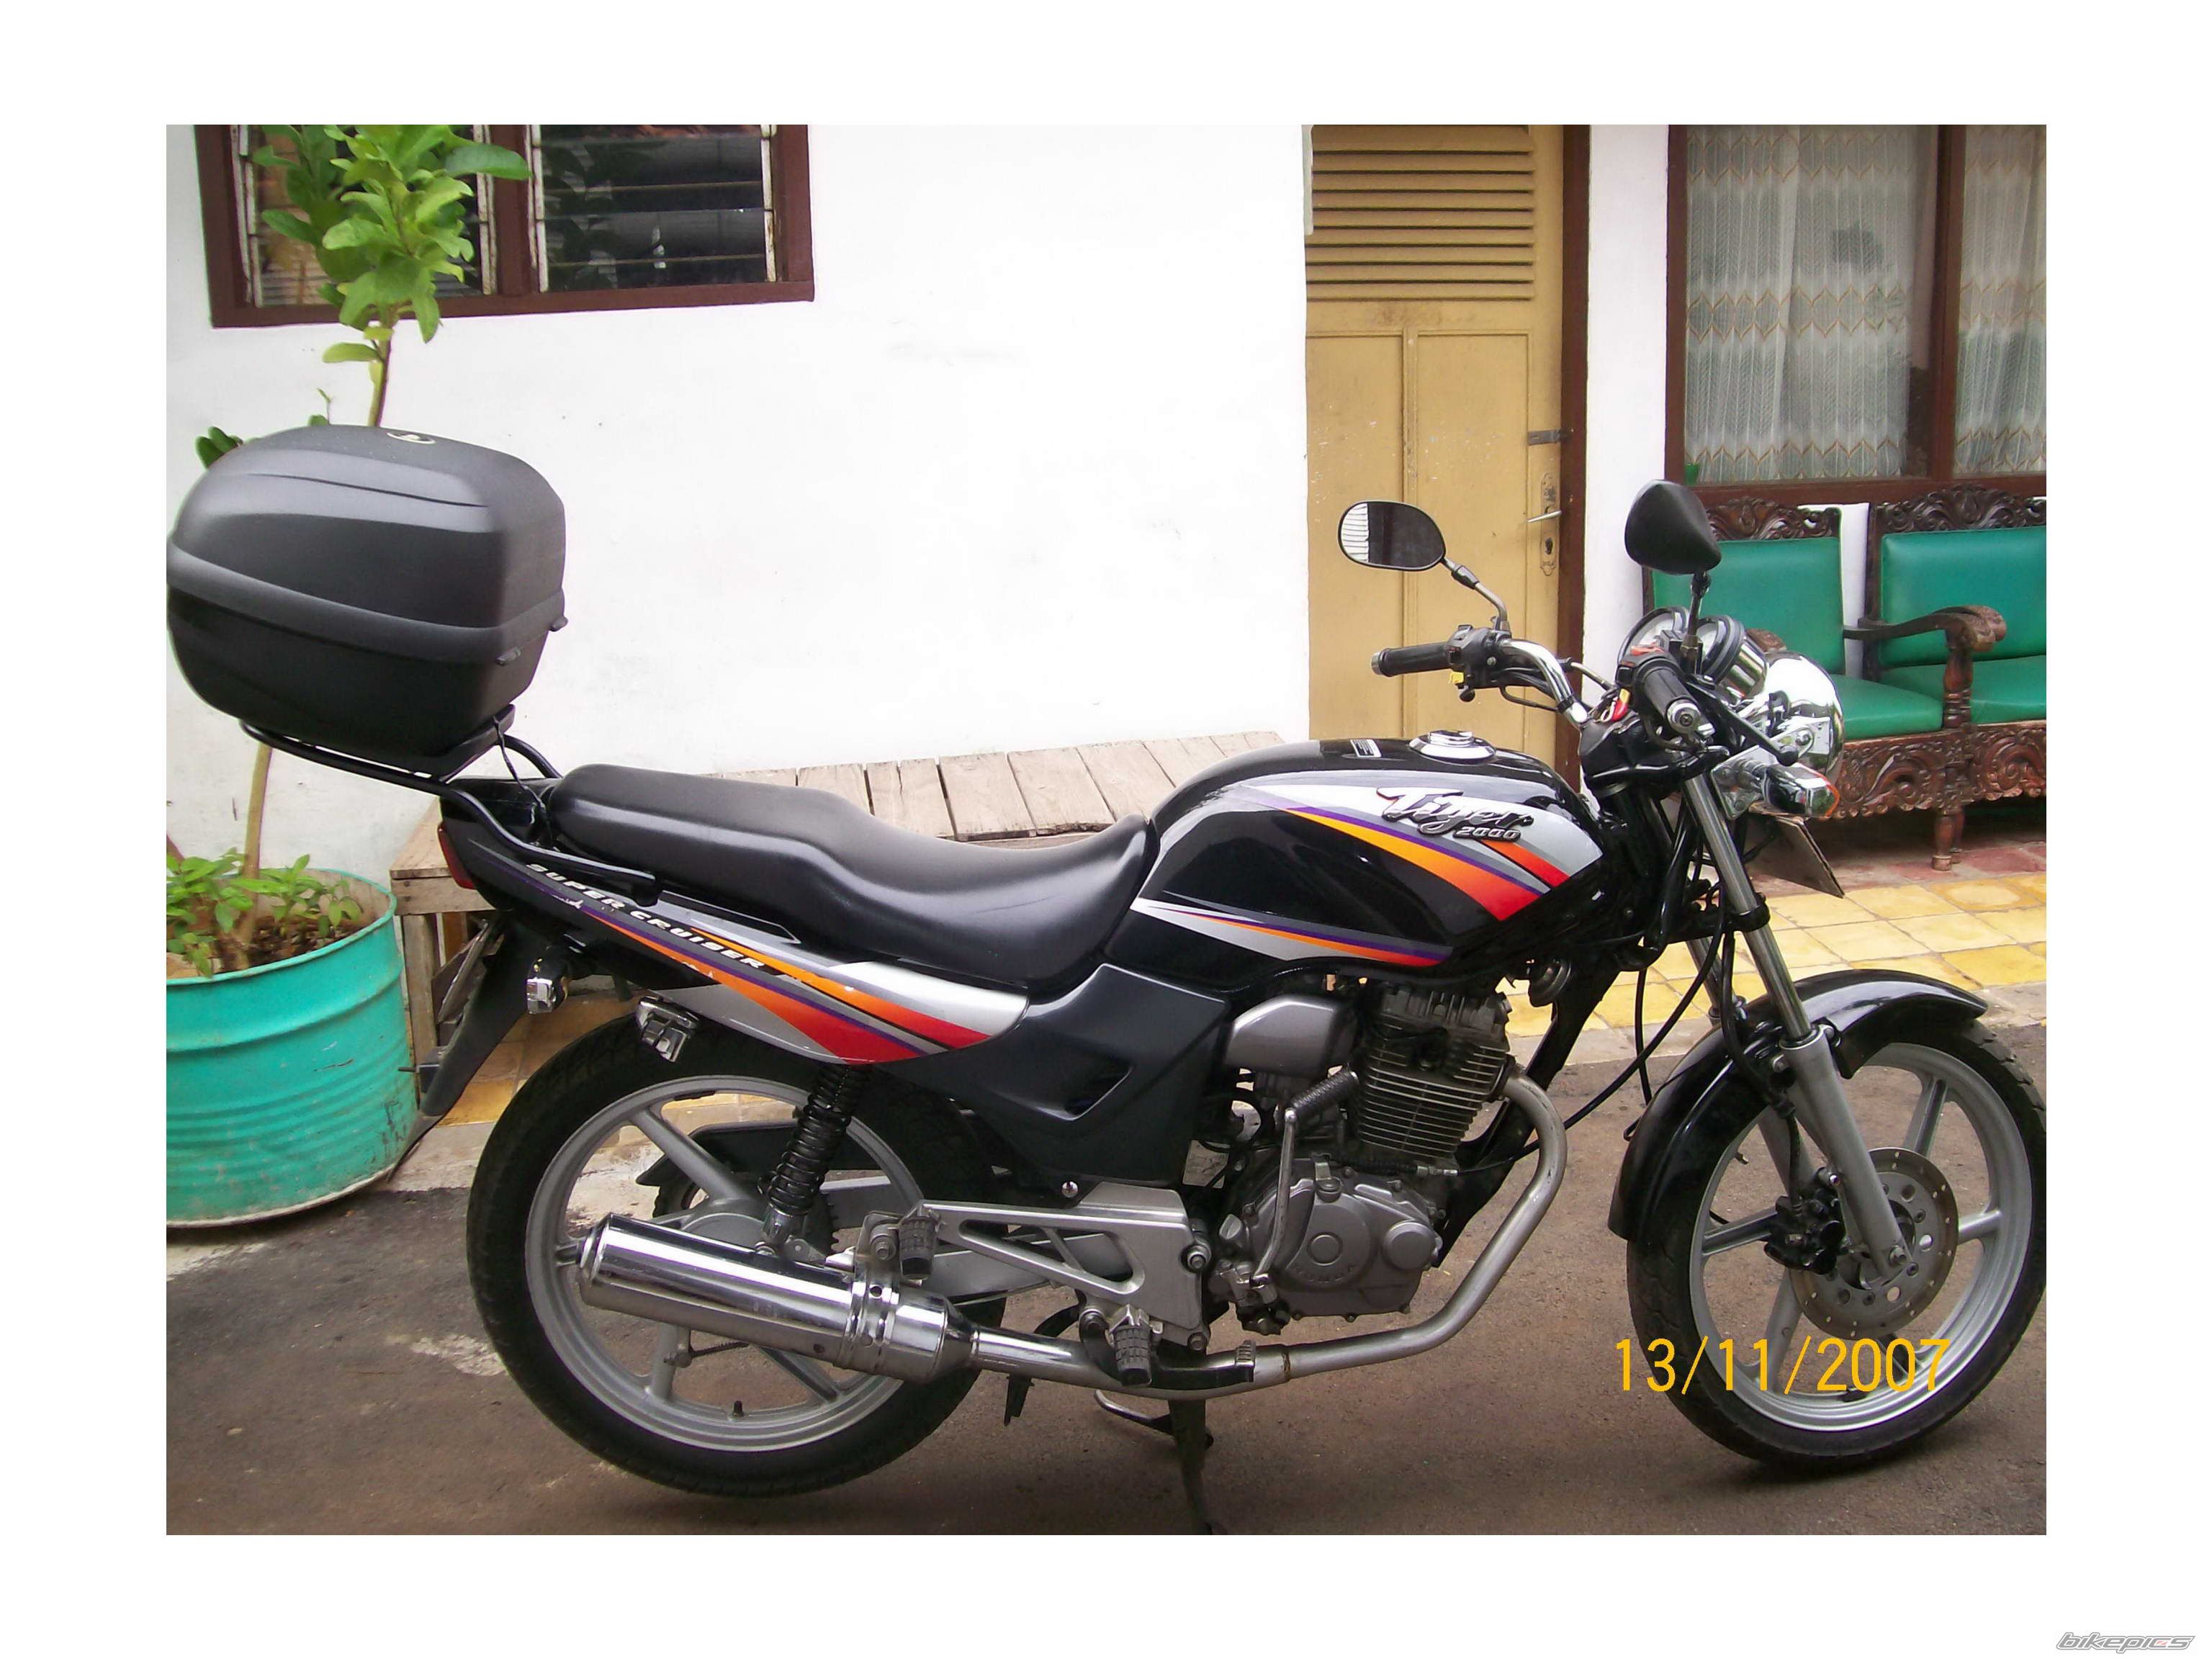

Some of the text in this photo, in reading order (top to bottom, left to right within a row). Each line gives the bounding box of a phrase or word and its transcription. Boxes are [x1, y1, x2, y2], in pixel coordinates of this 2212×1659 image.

[1376, 787, 1534, 835] Tiger
[1454, 826, 1521, 840] 2000
[526, 864, 765, 968] SUPER CRUISER
